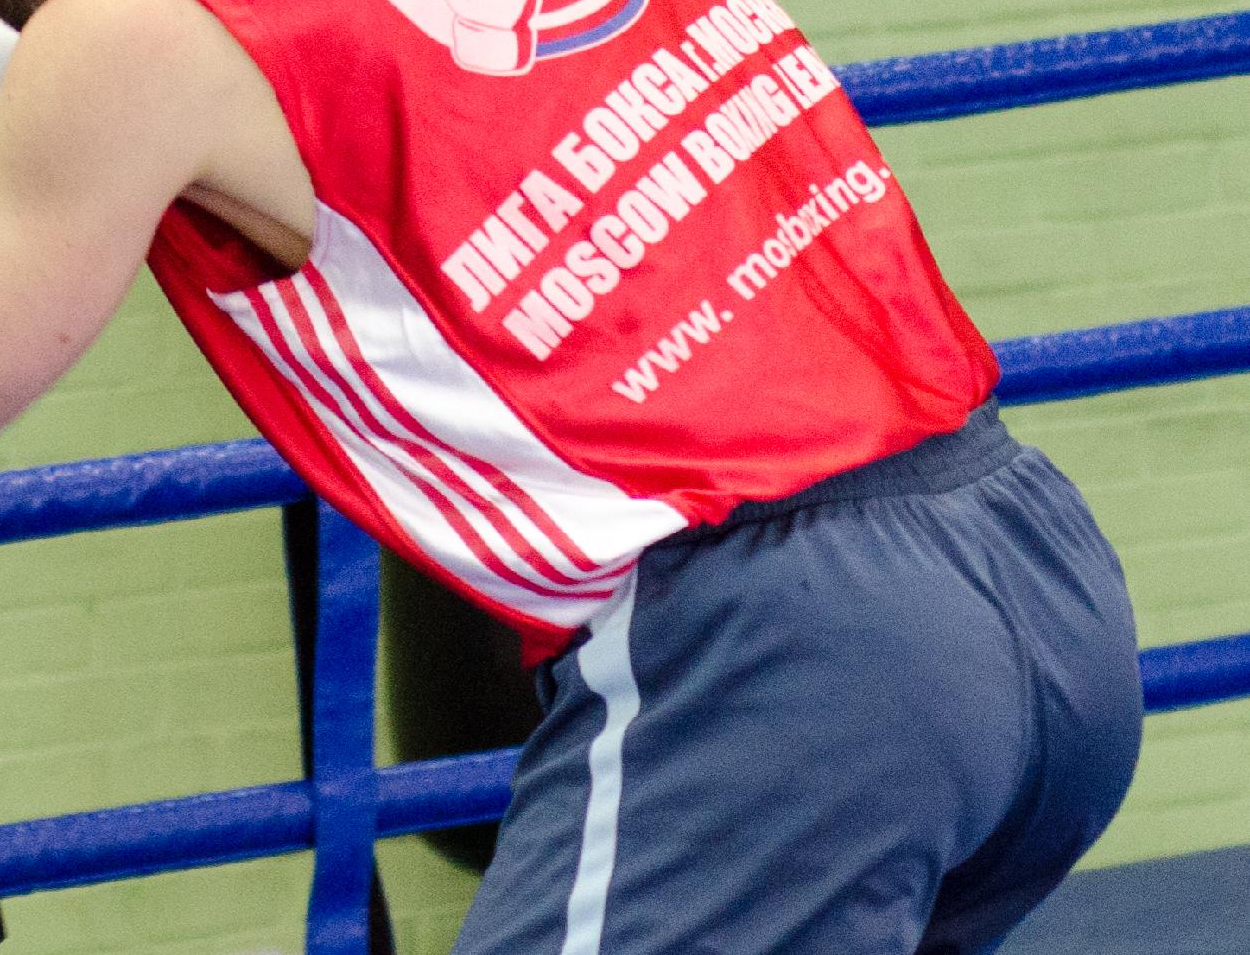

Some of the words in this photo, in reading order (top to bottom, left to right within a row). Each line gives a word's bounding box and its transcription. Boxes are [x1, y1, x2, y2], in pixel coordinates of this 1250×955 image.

[440, 169, 584, 313] ЛИГА
[551, 47, 710, 194] БОКСА
[502, 151, 708, 361] MOSCOW
[611, 299, 734, 404] www.
